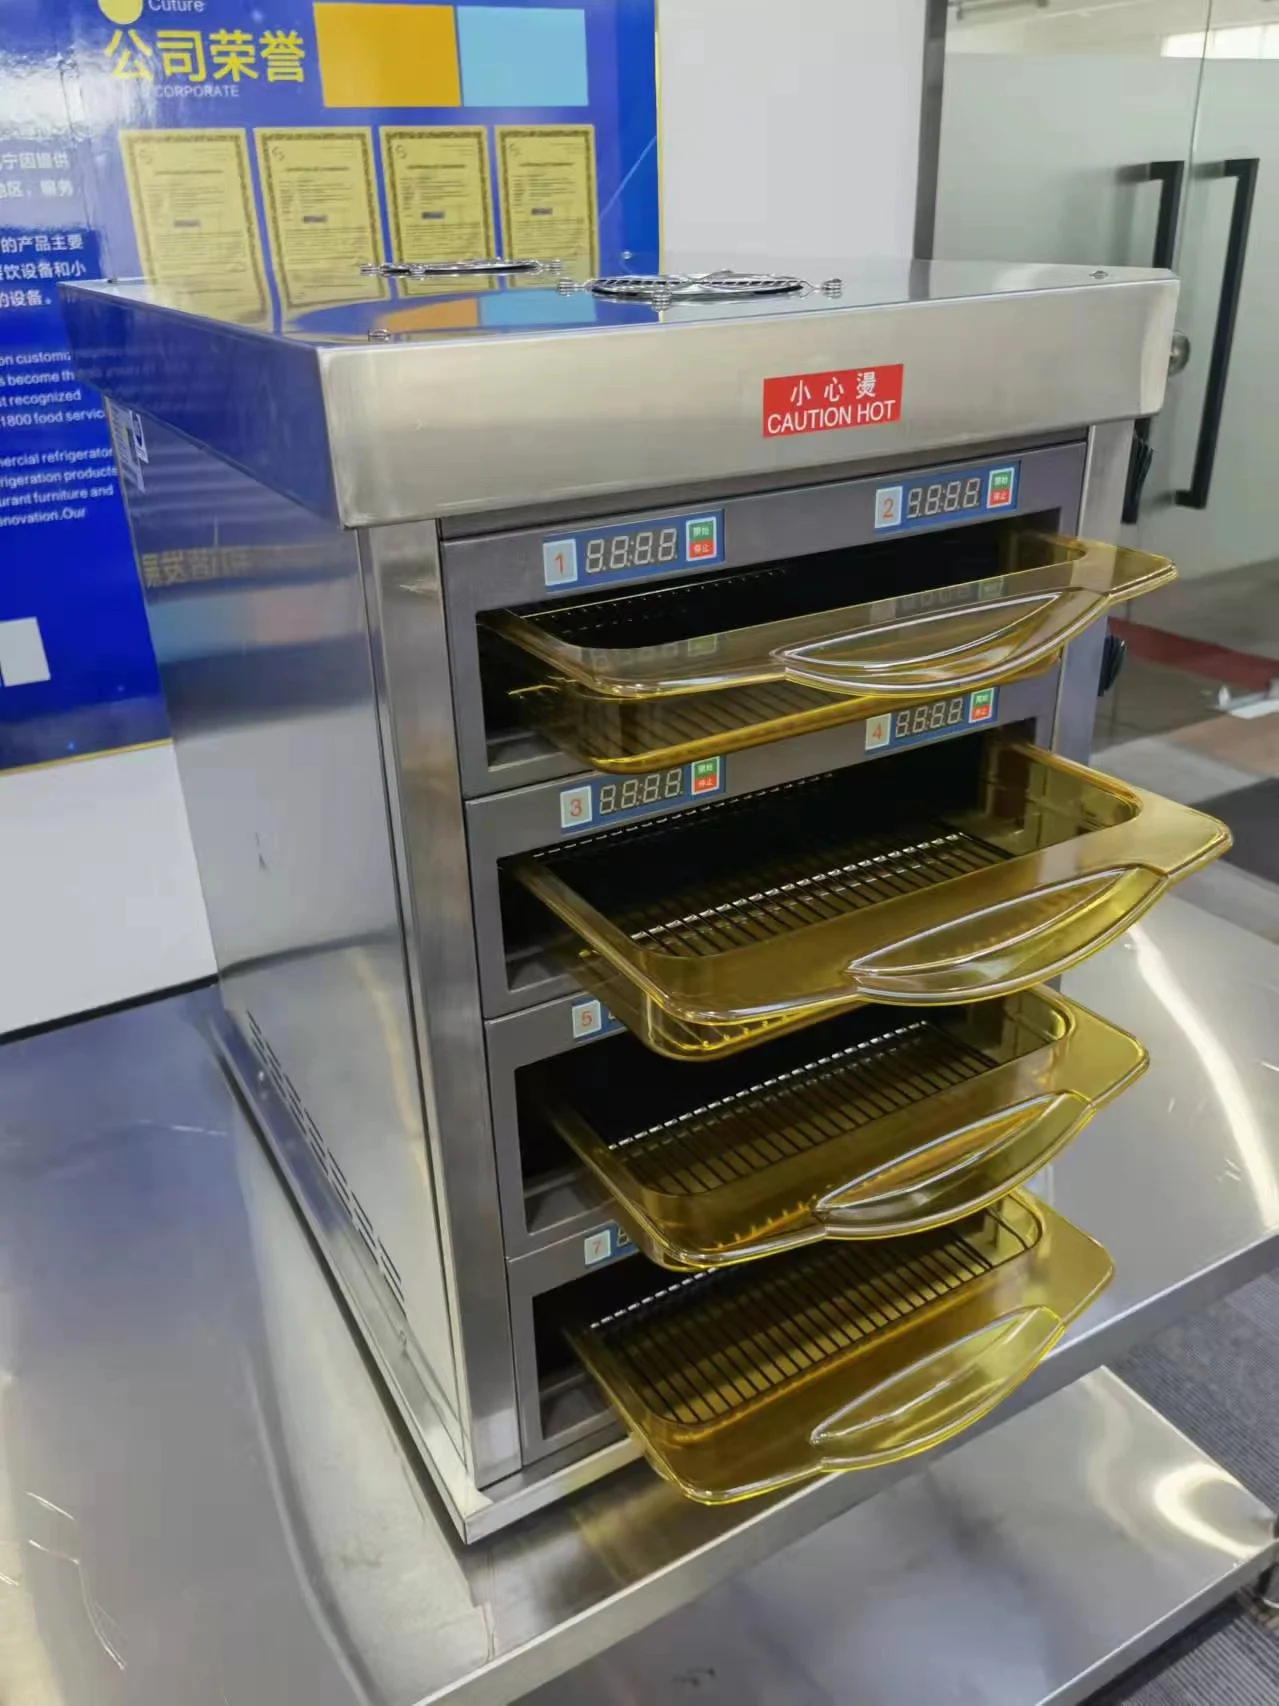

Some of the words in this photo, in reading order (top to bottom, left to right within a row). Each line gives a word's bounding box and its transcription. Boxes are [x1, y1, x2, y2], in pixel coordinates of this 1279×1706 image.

[104, 28, 306, 83] 公司荣誉
[155, 84, 240, 98] CORPORATE
[1, 232, 84, 253] 的产品主要
[0, 260, 87, 280] 饮设备和小
[7, 373, 60, 386] become
[9, 390, 82, 407] recognized
[1, 414, 32, 427] 1800
[33, 410, 64, 424] food
[767, 405, 852, 434] CAUTION
[857, 399, 896, 423] HOT
[33, 490, 89, 504] furniture
[90, 485, 114, 498] and
[882, 497, 895, 521] 2
[554, 552, 565, 576] 1
[871, 723, 883, 740] 4
[570, 798, 583, 817] 3
[581, 1010, 593, 1027] 5
[591, 1239, 603, 1256] 7
